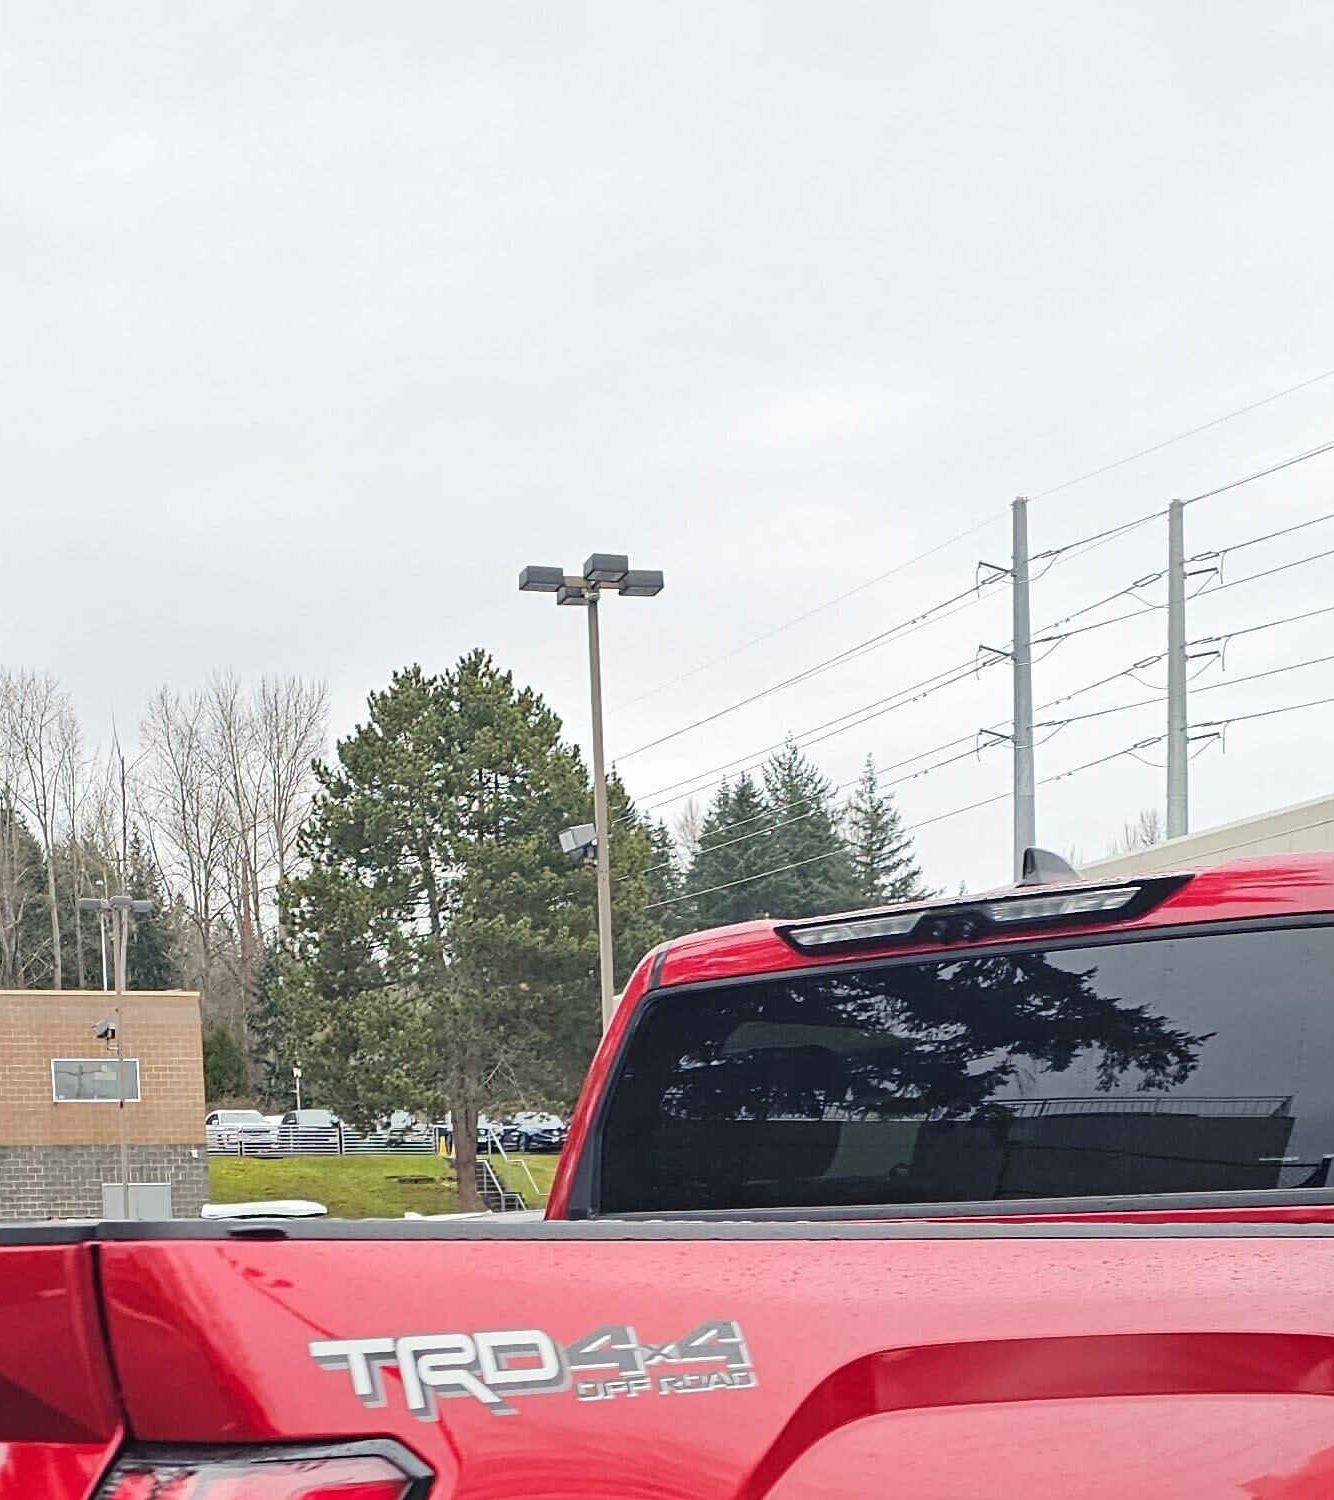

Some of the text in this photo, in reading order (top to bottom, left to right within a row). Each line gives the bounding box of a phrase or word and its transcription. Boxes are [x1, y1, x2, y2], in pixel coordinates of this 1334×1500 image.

[308, 1328, 571, 1422] TRD
[575, 1369, 759, 1402] OFF ROAD
